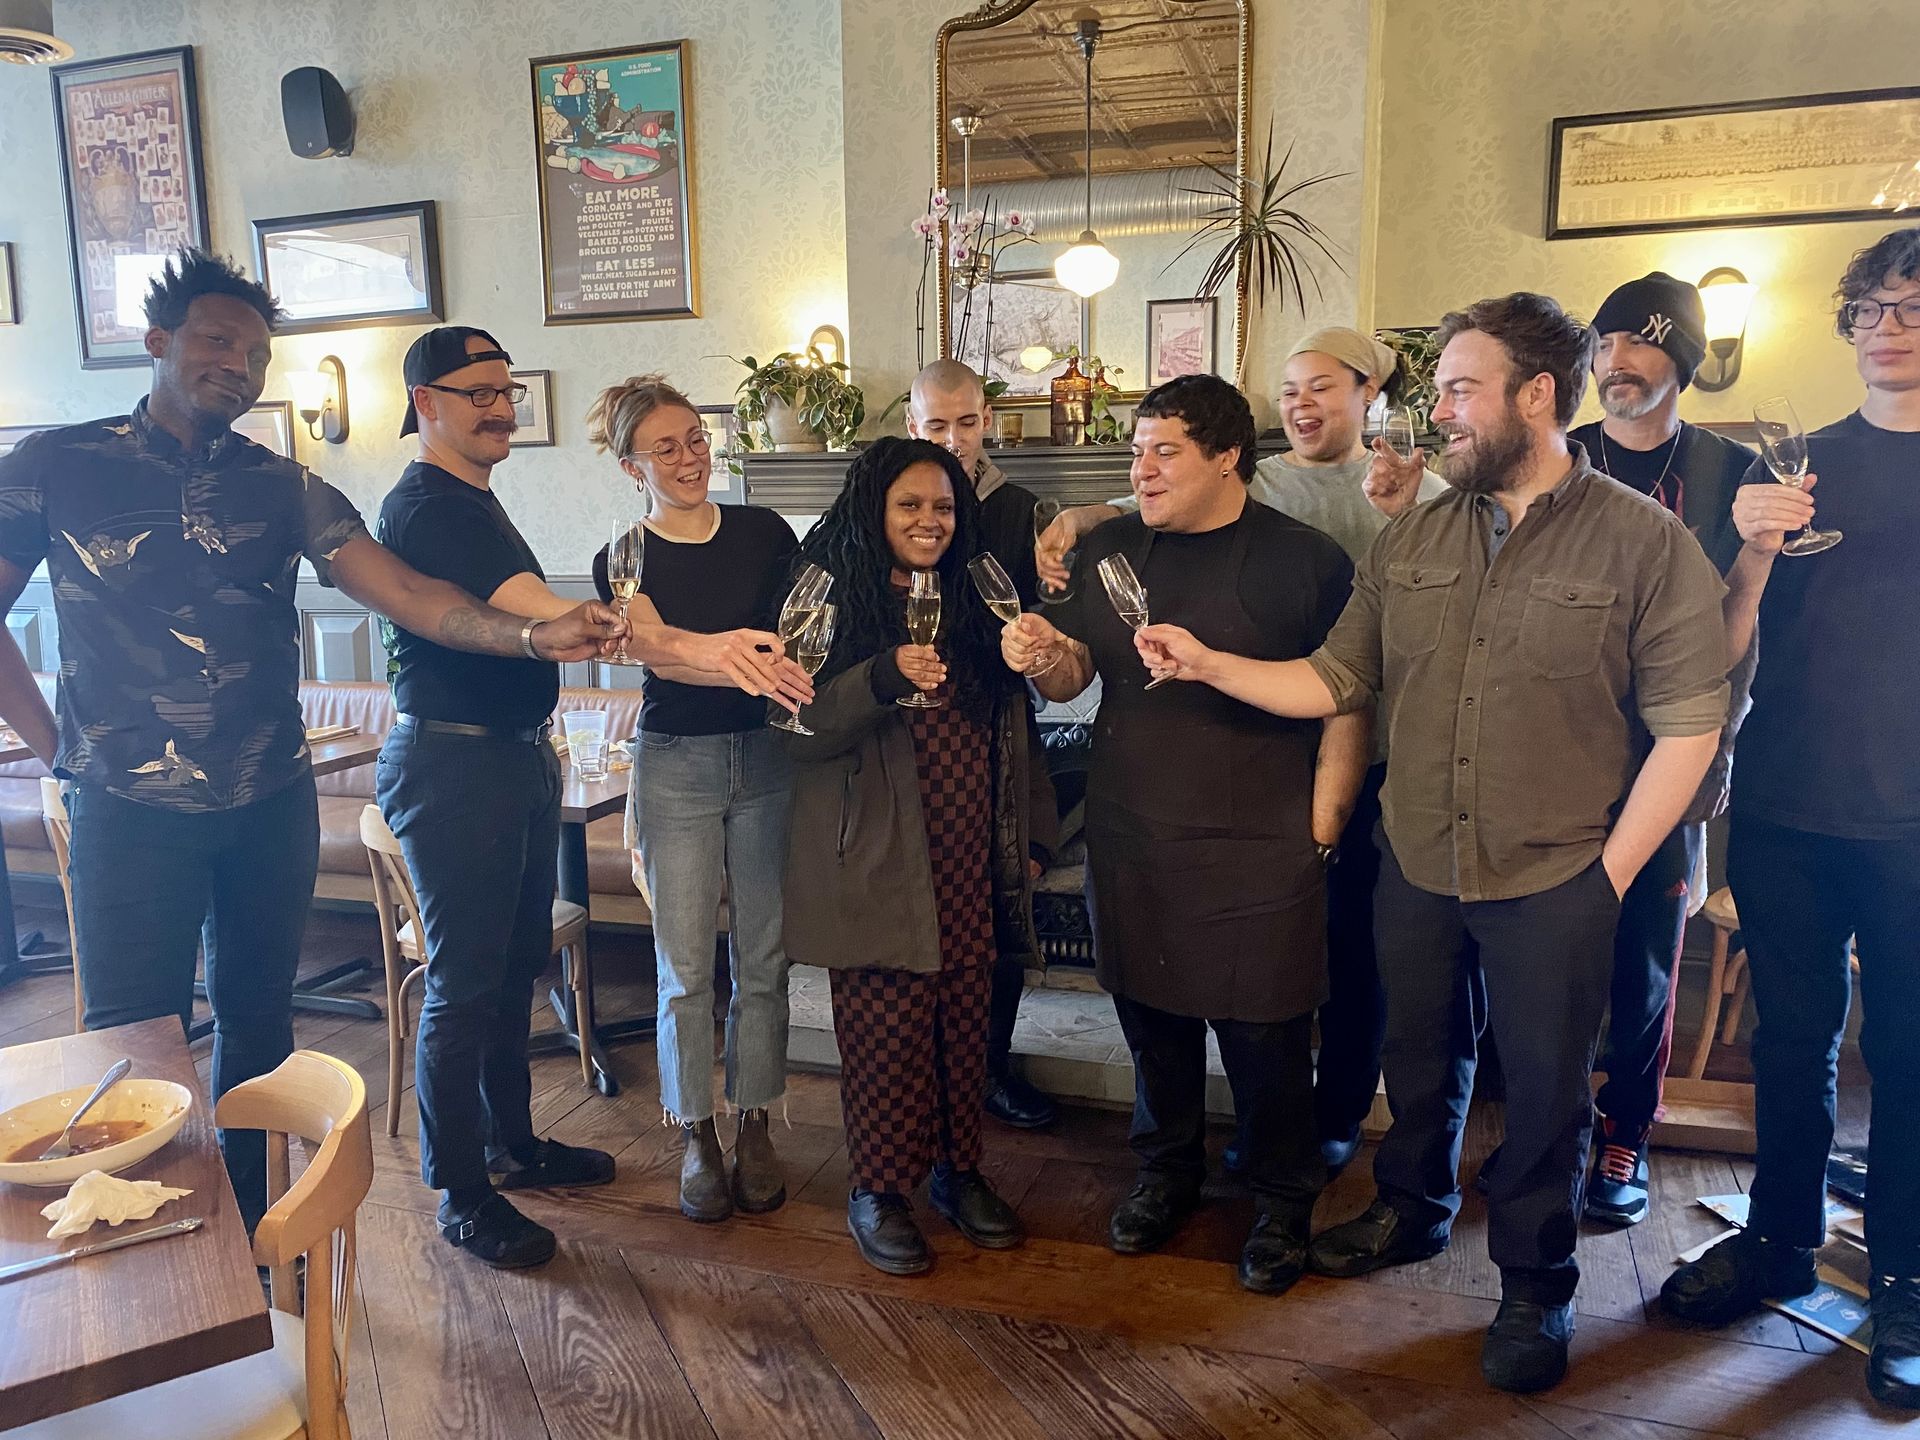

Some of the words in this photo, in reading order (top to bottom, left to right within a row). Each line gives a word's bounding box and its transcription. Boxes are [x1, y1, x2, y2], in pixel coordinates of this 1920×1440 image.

[621, 66, 661, 76] ADMINISTRATION
[585, 190, 612, 205] EAT
[617, 185, 660, 201] MORE
[655, 198, 673, 207] RYE
[650, 207, 673, 217] FISH
[578, 229, 620, 238] VEGETABLES
[635, 225, 674, 234] POTATOES
[658, 233, 675, 241] AND
[578, 246, 617, 257] BROILED
[620, 244, 652, 254] FOODS
[595, 259, 620, 272] EAT
[625, 257, 655, 270] LESS
[625, 269, 647, 278] SUGAR
[660, 268, 676, 276] FATS
[581, 284, 592, 292] TO
[594, 283, 615, 292] SAVE
[616, 282, 632, 291] FOR
[633, 280, 650, 289] THE
[653, 278, 677, 288] ARMY
[582, 293, 600, 302] AND
[601, 291, 618, 300] OUR
[620, 289, 648, 299] ALLIES
[1641, 313, 1672, 344] NY
